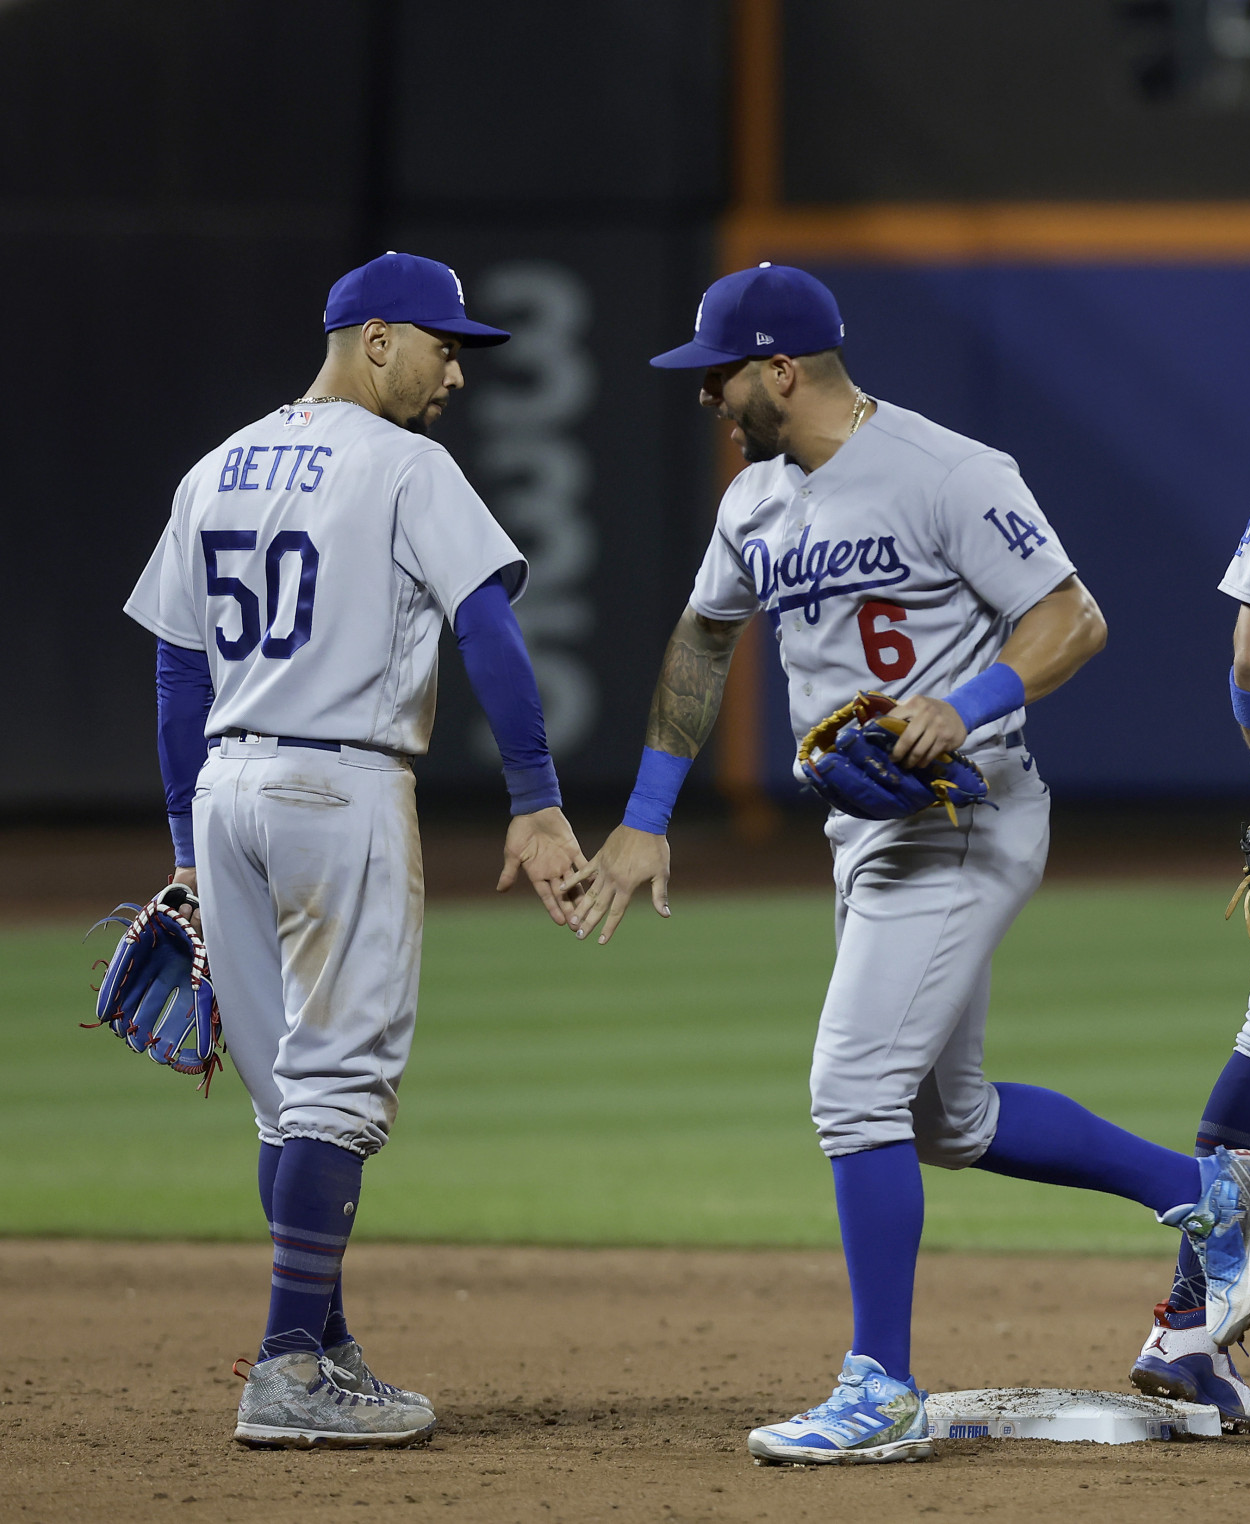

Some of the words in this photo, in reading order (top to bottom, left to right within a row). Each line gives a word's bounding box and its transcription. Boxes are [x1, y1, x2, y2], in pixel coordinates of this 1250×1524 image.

[217, 445, 333, 493] BETTS
[983, 506, 1048, 560] LA
[200, 530, 320, 661] 50
[857, 600, 918, 683] 6
[949, 1425, 966, 1438] CITI
